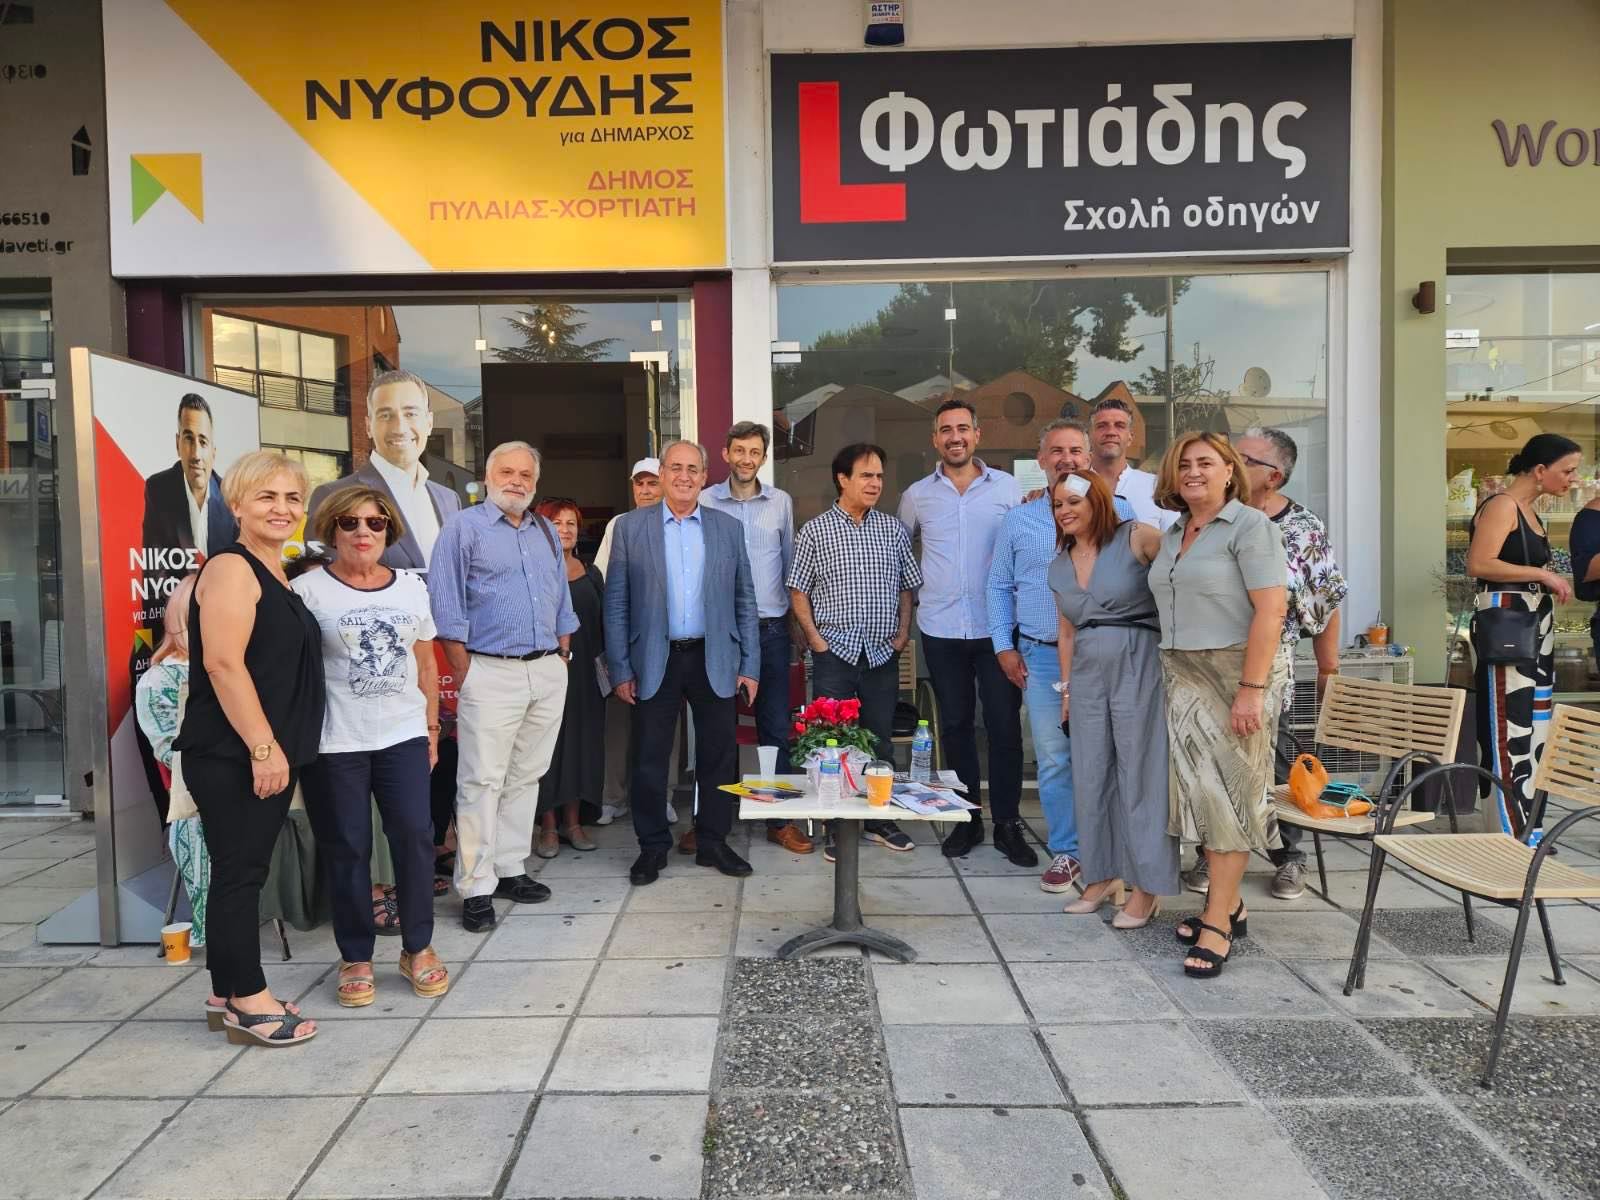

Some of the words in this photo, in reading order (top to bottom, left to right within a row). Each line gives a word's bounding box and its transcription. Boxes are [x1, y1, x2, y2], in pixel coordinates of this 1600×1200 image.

[481, 17, 691, 62] ΝΙΚΟΣ
[306, 73, 693, 121] ΝΥΦΟΥΔΗΣ
[560, 131, 585, 146] για
[591, 125, 694, 142] ΔΗΜΑΡΧΟΣ
[860, 83, 1307, 179] Φωτιάδης
[588, 169, 693, 191] ΔΗΜΟΣ
[0, 211, 50, 225] 66510
[429, 197, 696, 221] ΠΥΛΑΙΑΣ-ΧΟΡΤΙΑΤΗ
[1064, 196, 1170, 231] Σχολή
[1183, 193, 1321, 232] οδηγών
[129, 547, 201, 571] ΝΙΚΟΣ
[130, 576, 181, 601] ΝΥΦ
[132, 609, 147, 623] για
